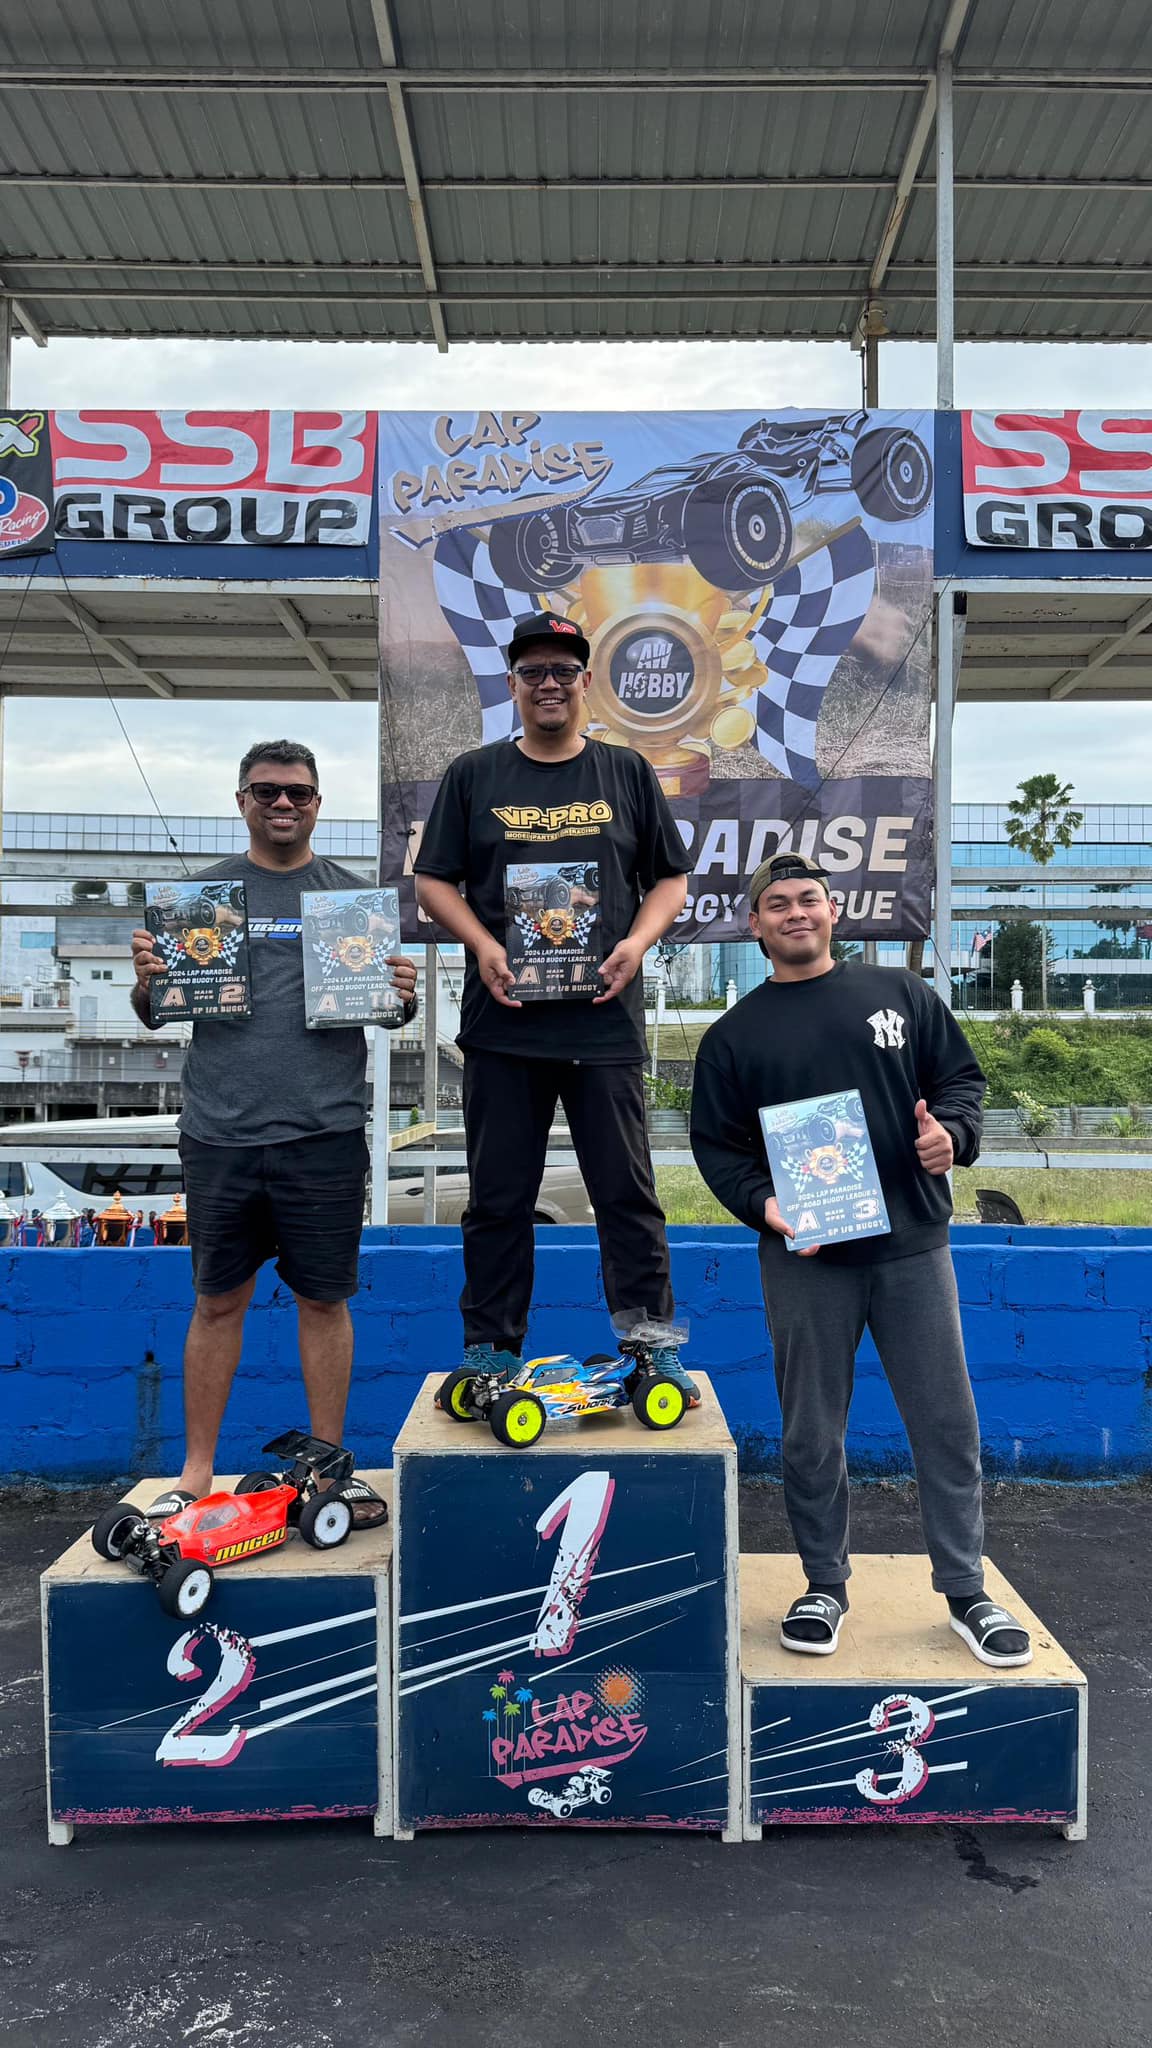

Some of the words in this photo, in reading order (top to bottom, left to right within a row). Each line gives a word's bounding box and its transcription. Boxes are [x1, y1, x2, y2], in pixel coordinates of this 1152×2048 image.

[54, 411, 367, 487] SSB
[432, 411, 541, 457] LAP
[971, 410, 1152, 491] SS
[54, 493, 358, 544] GROUP
[976, 501, 1152, 549] GRO
[636, 642, 674, 669] AW
[618, 671, 691, 699] HOBBY
[248, 923, 303, 932] ugen
[673, 893, 746, 923] GGY
[516, 964, 541, 985] A
[160, 986, 187, 1007] A
[218, 983, 246, 1004] 2
[314, 993, 340, 1013] A
[866, 1008, 906, 1050] NY
[795, 1209, 821, 1233] A
[852, 1198, 880, 1220] 3
[534, 1471, 616, 1658] 1
[155, 1622, 257, 1768] 2
[531, 1690, 594, 1728] LAP
[855, 1693, 936, 1805] 3
